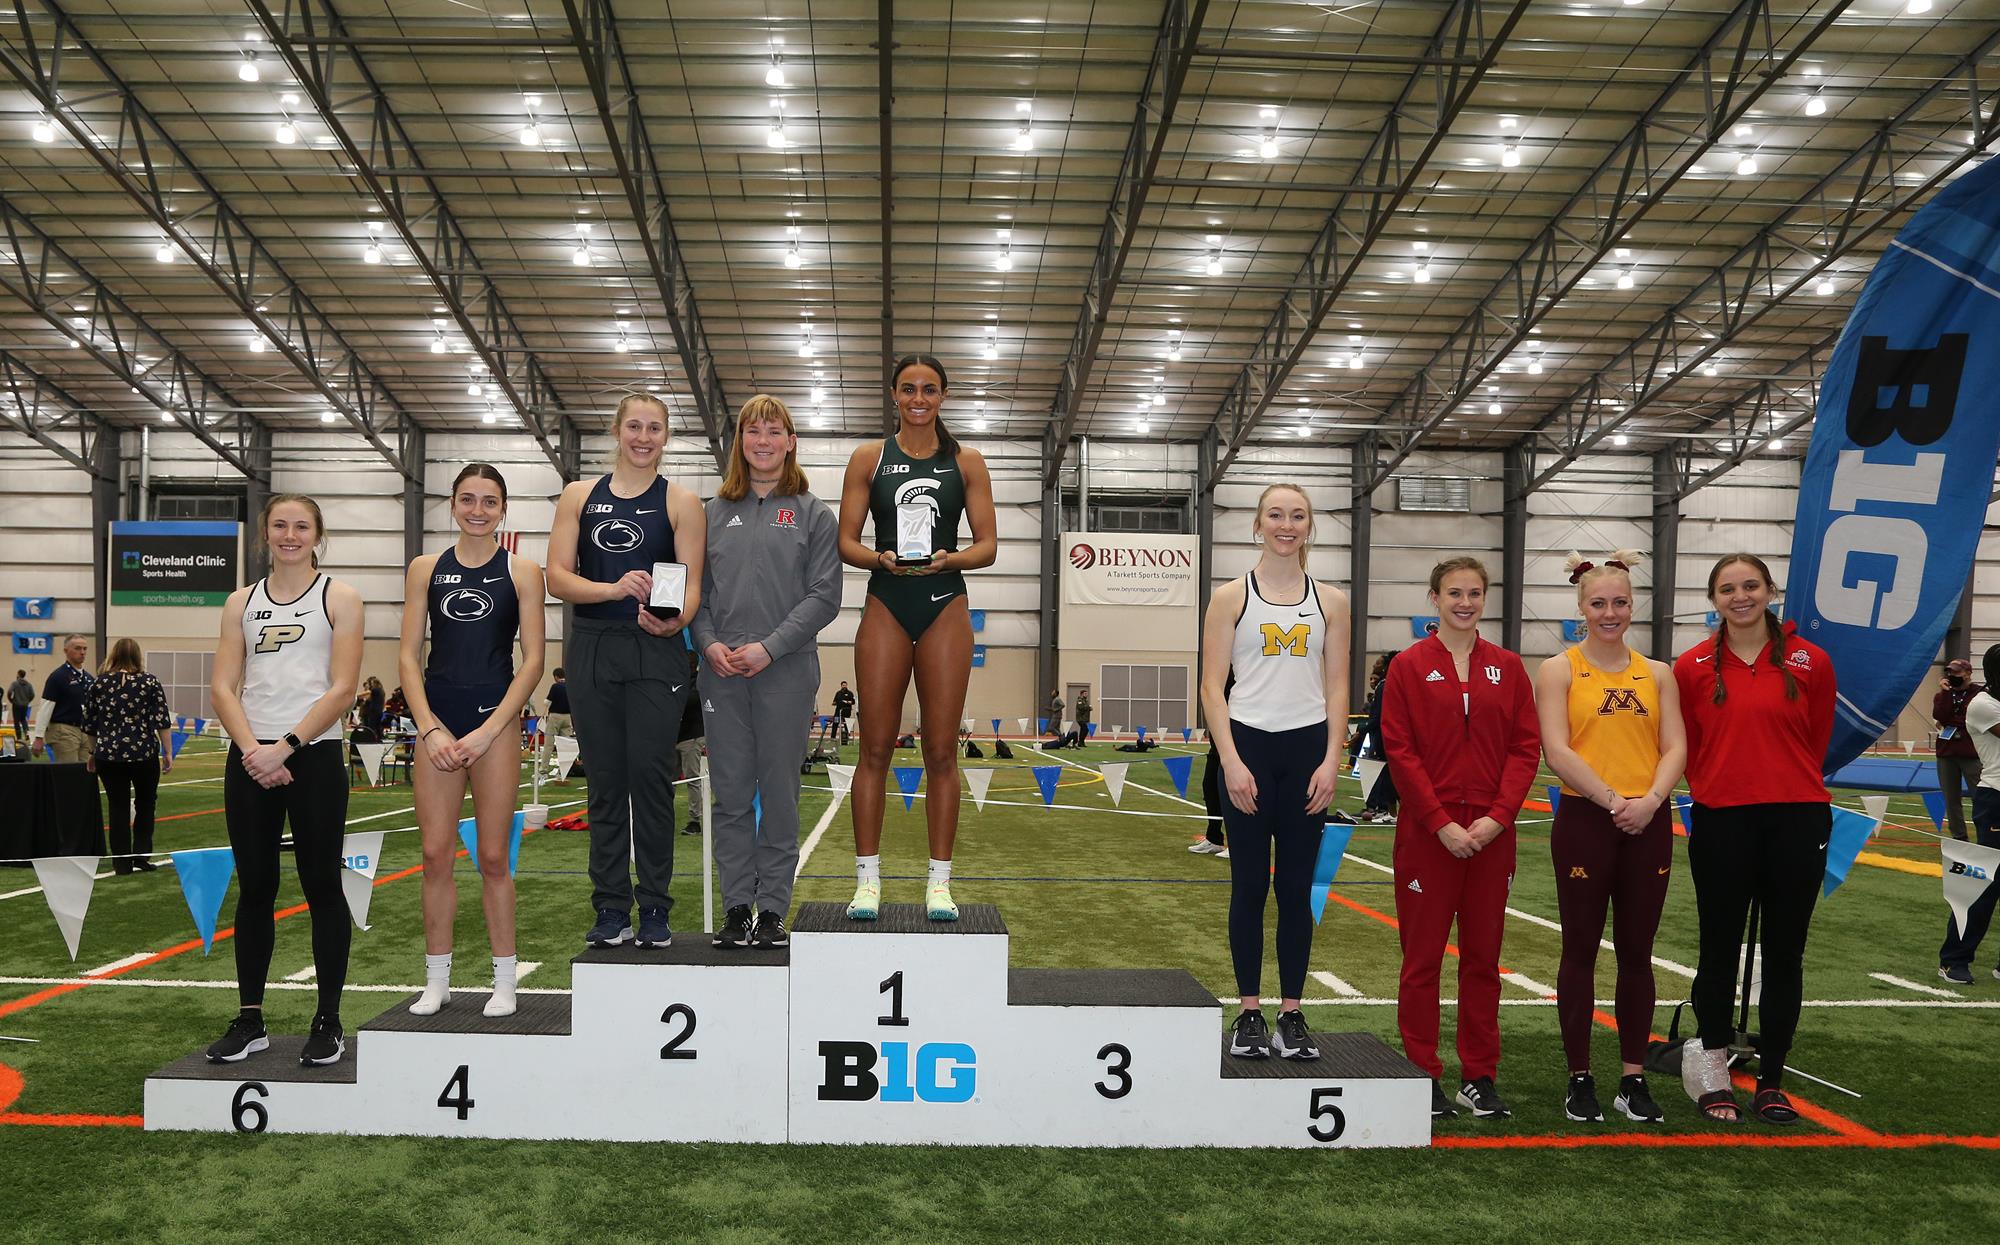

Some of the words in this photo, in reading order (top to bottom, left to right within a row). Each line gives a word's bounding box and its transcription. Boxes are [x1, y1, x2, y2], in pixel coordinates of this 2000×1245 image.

[776, 509, 795, 524] R
[142, 555, 194, 566] Cleveland
[196, 555, 226, 567] Clinic
[1099, 548, 1192, 567] BEYNON
[142, 570, 164, 578] Sports
[1161, 572, 1191, 580] Company
[142, 594, 205, 604] sports-health.org
[255, 624, 305, 654] P
[1260, 622, 1310, 657] M
[1597, 688, 1648, 716] M
[1569, 866, 1588, 879] M
[878, 971, 909, 1026] 1
[661, 1004, 696, 1059] 2
[1095, 1043, 1132, 1099] 3
[438, 1065, 474, 1120] 4
[232, 1082, 269, 1133] 6
[1307, 1087, 1346, 1142] 5
